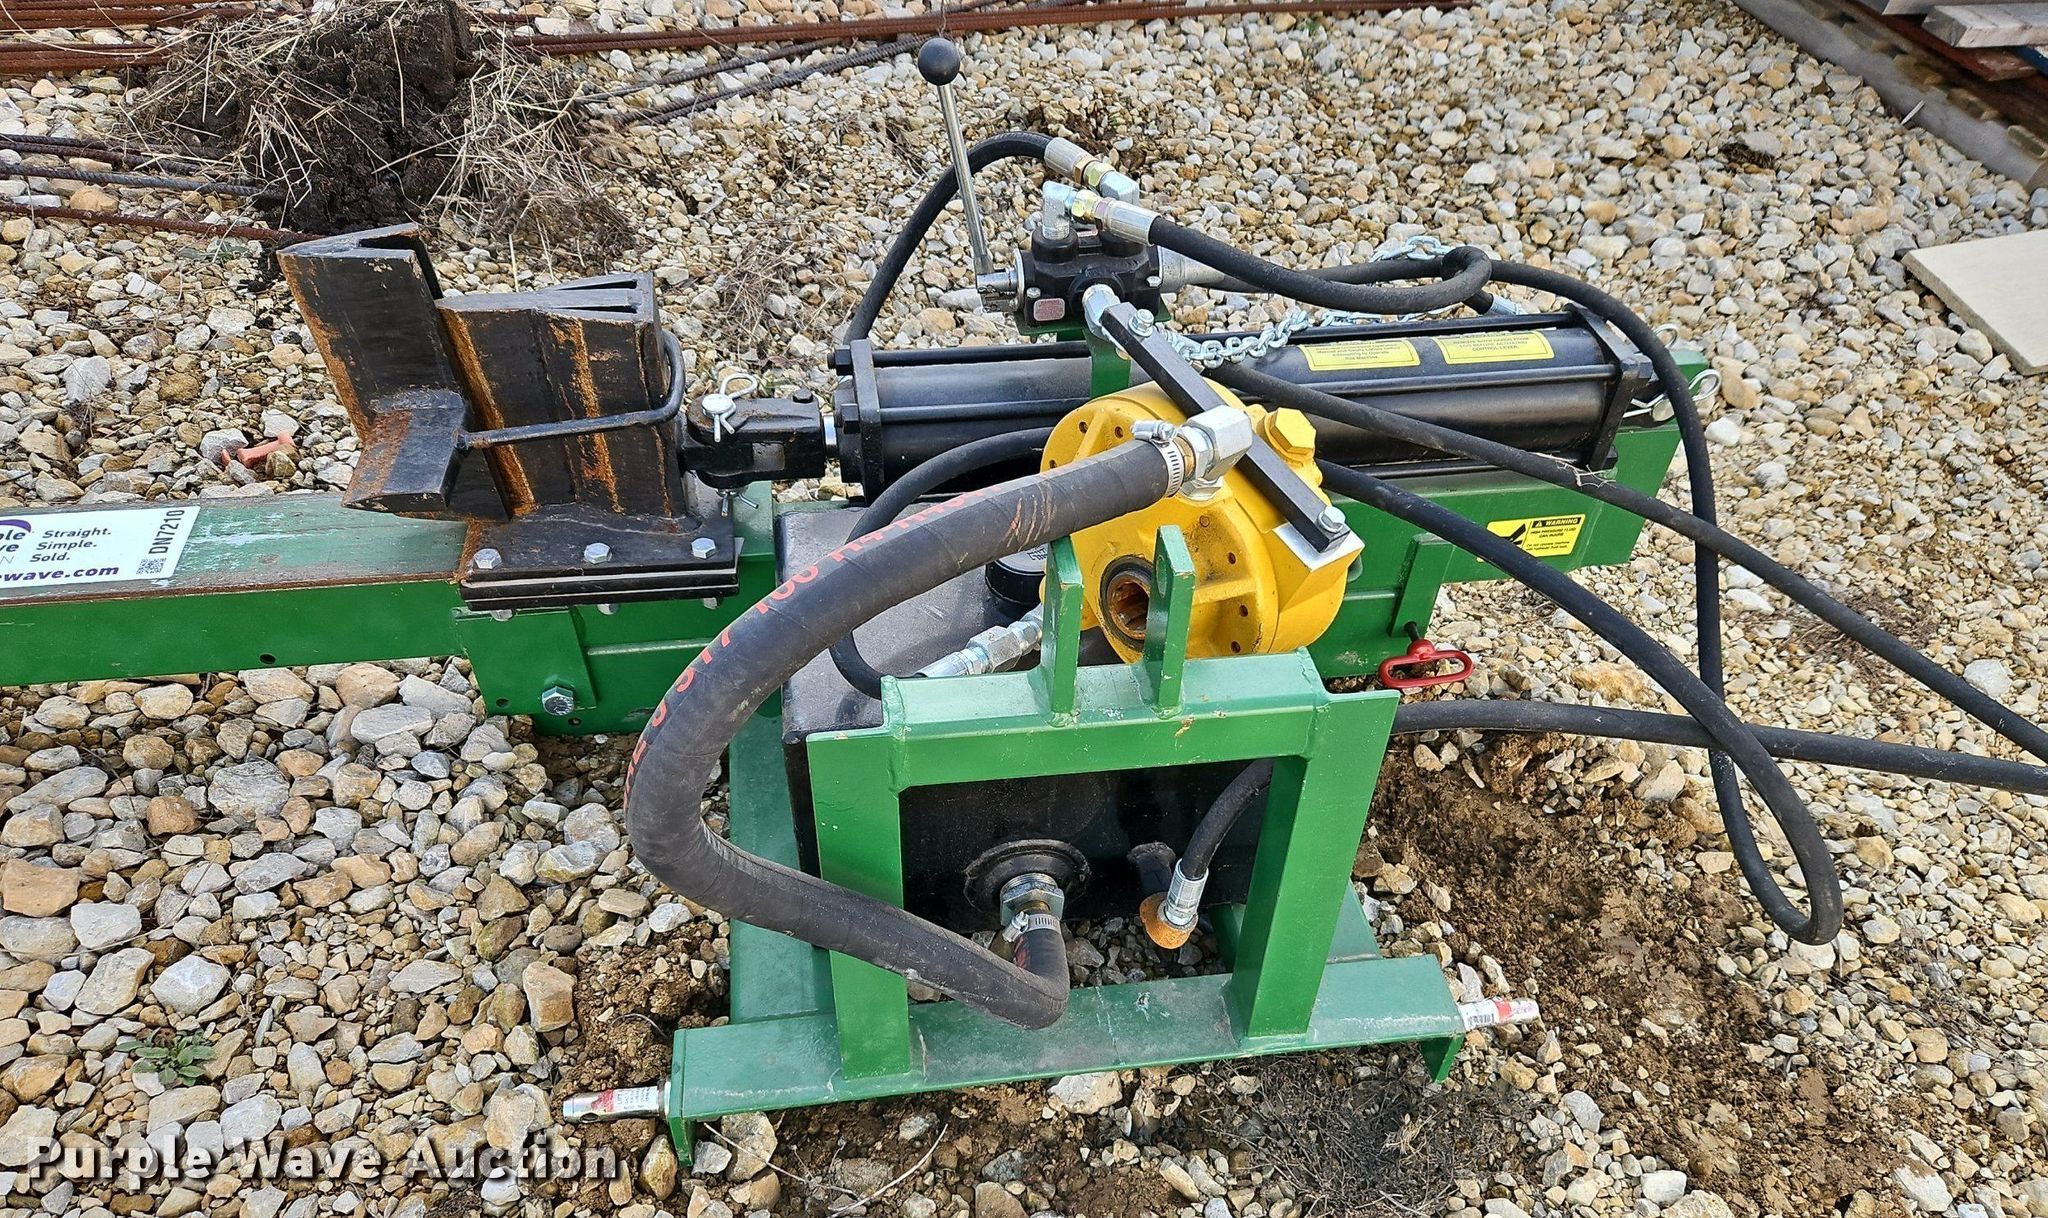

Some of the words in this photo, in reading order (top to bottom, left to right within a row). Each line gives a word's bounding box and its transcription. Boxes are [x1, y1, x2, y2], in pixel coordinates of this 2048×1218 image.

[1545, 518, 1578, 526] WARNING
[42, 527, 112, 539] Straight.
[149, 509, 186, 555] DN7210
[36, 541, 97, 551] Simple.
[29, 552, 71, 562] Sold.
[0, 566, 119, 582] wave.com
